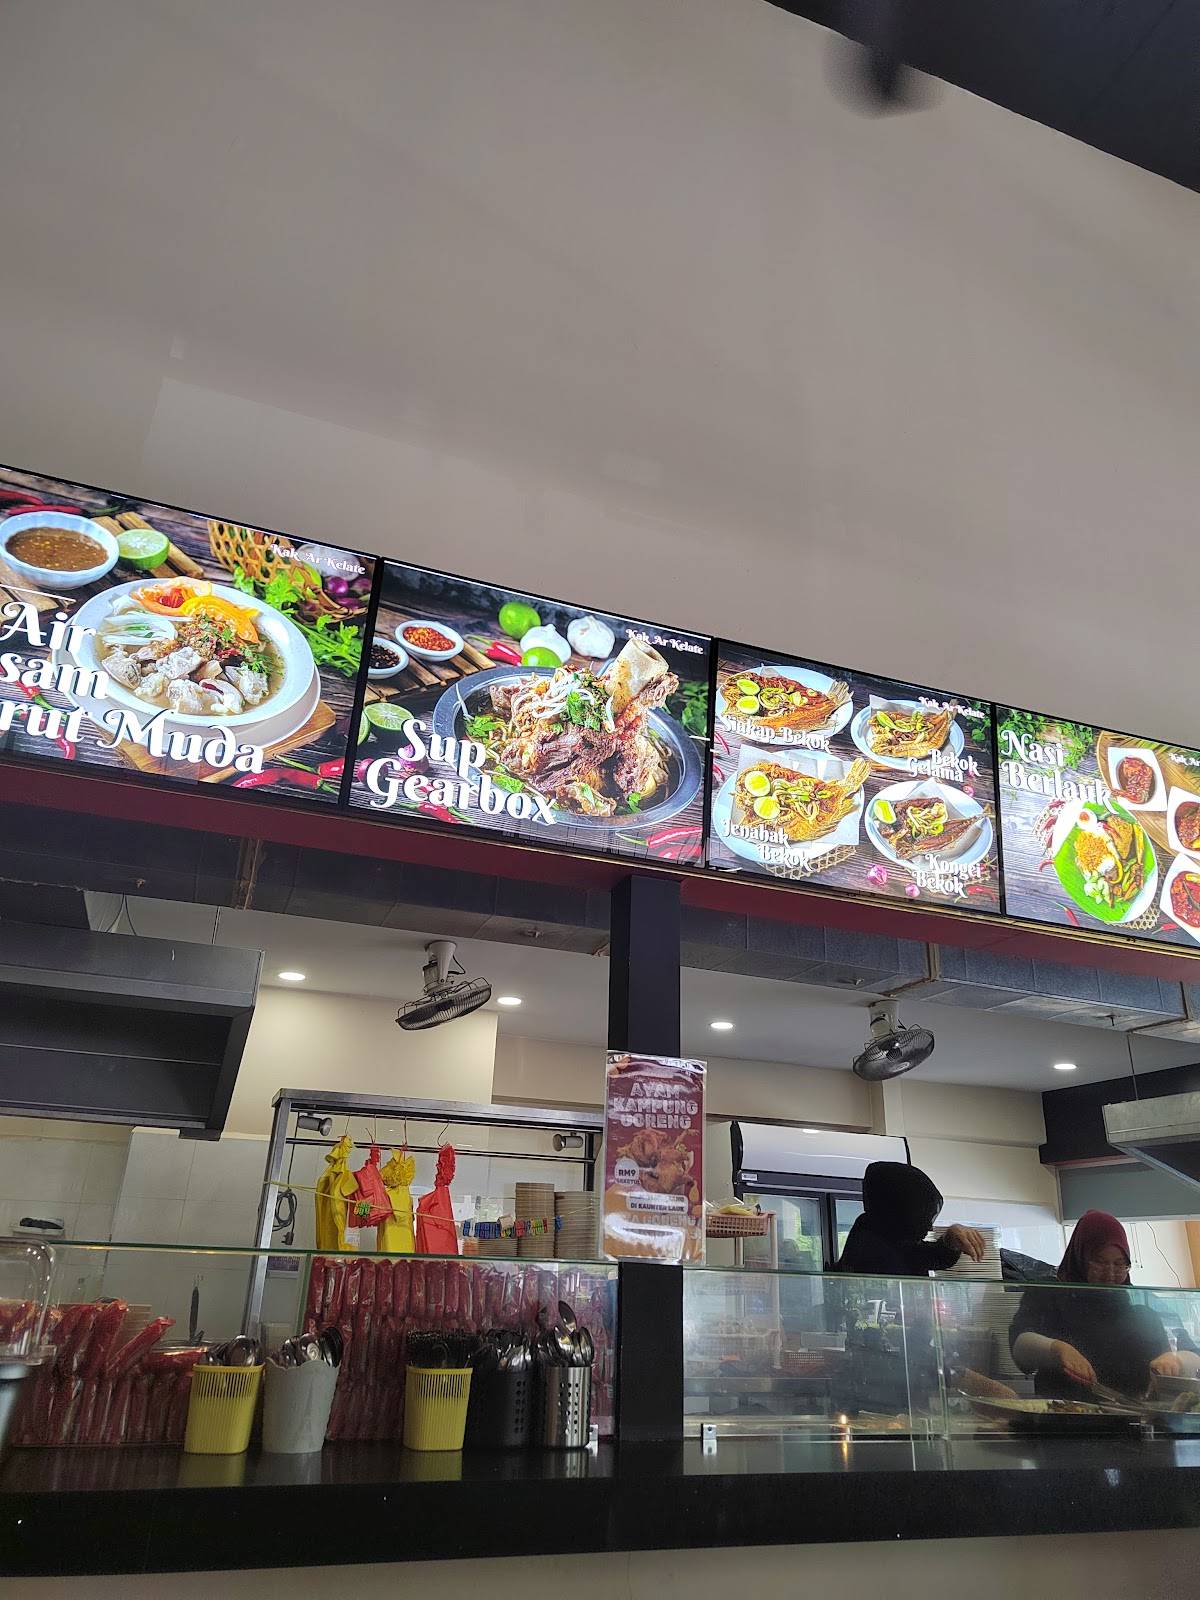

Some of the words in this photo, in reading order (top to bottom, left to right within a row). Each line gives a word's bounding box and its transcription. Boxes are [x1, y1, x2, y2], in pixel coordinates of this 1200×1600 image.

[270, 544, 300, 561] Kak
[303, 552, 320, 564] Ar
[324, 557, 366, 574] Kelate
[0, 601, 97, 653] Air
[625, 629, 652, 645] Kak
[652, 635, 668, 647] Ar
[669, 638, 704, 655] Kelate
[0, 652, 110, 700] sam
[918, 696, 941, 711] Kak
[955, 705, 985, 719] Kelate
[97, 709, 265, 774] Muda
[398, 718, 487, 778] Sup
[722, 714, 776, 743] Siakap
[779, 726, 834, 755] Bekok
[1000, 730, 1064, 766] Nasi
[907, 758, 964, 783] Gelama
[928, 749, 981, 776] Bekok
[366, 757, 557, 825] Gearbox
[1000, 760, 1120, 815] Berlauk
[722, 819, 790, 848] Jenahak
[757, 843, 812, 871] Bekok
[925, 853, 982, 880] Kongei
[912, 868, 968, 898] Bekok
[630, 1082, 681, 1098] AYAM
[613, 1097, 699, 1115] KAMPUNG
[618, 1169, 636, 1177] RM9
